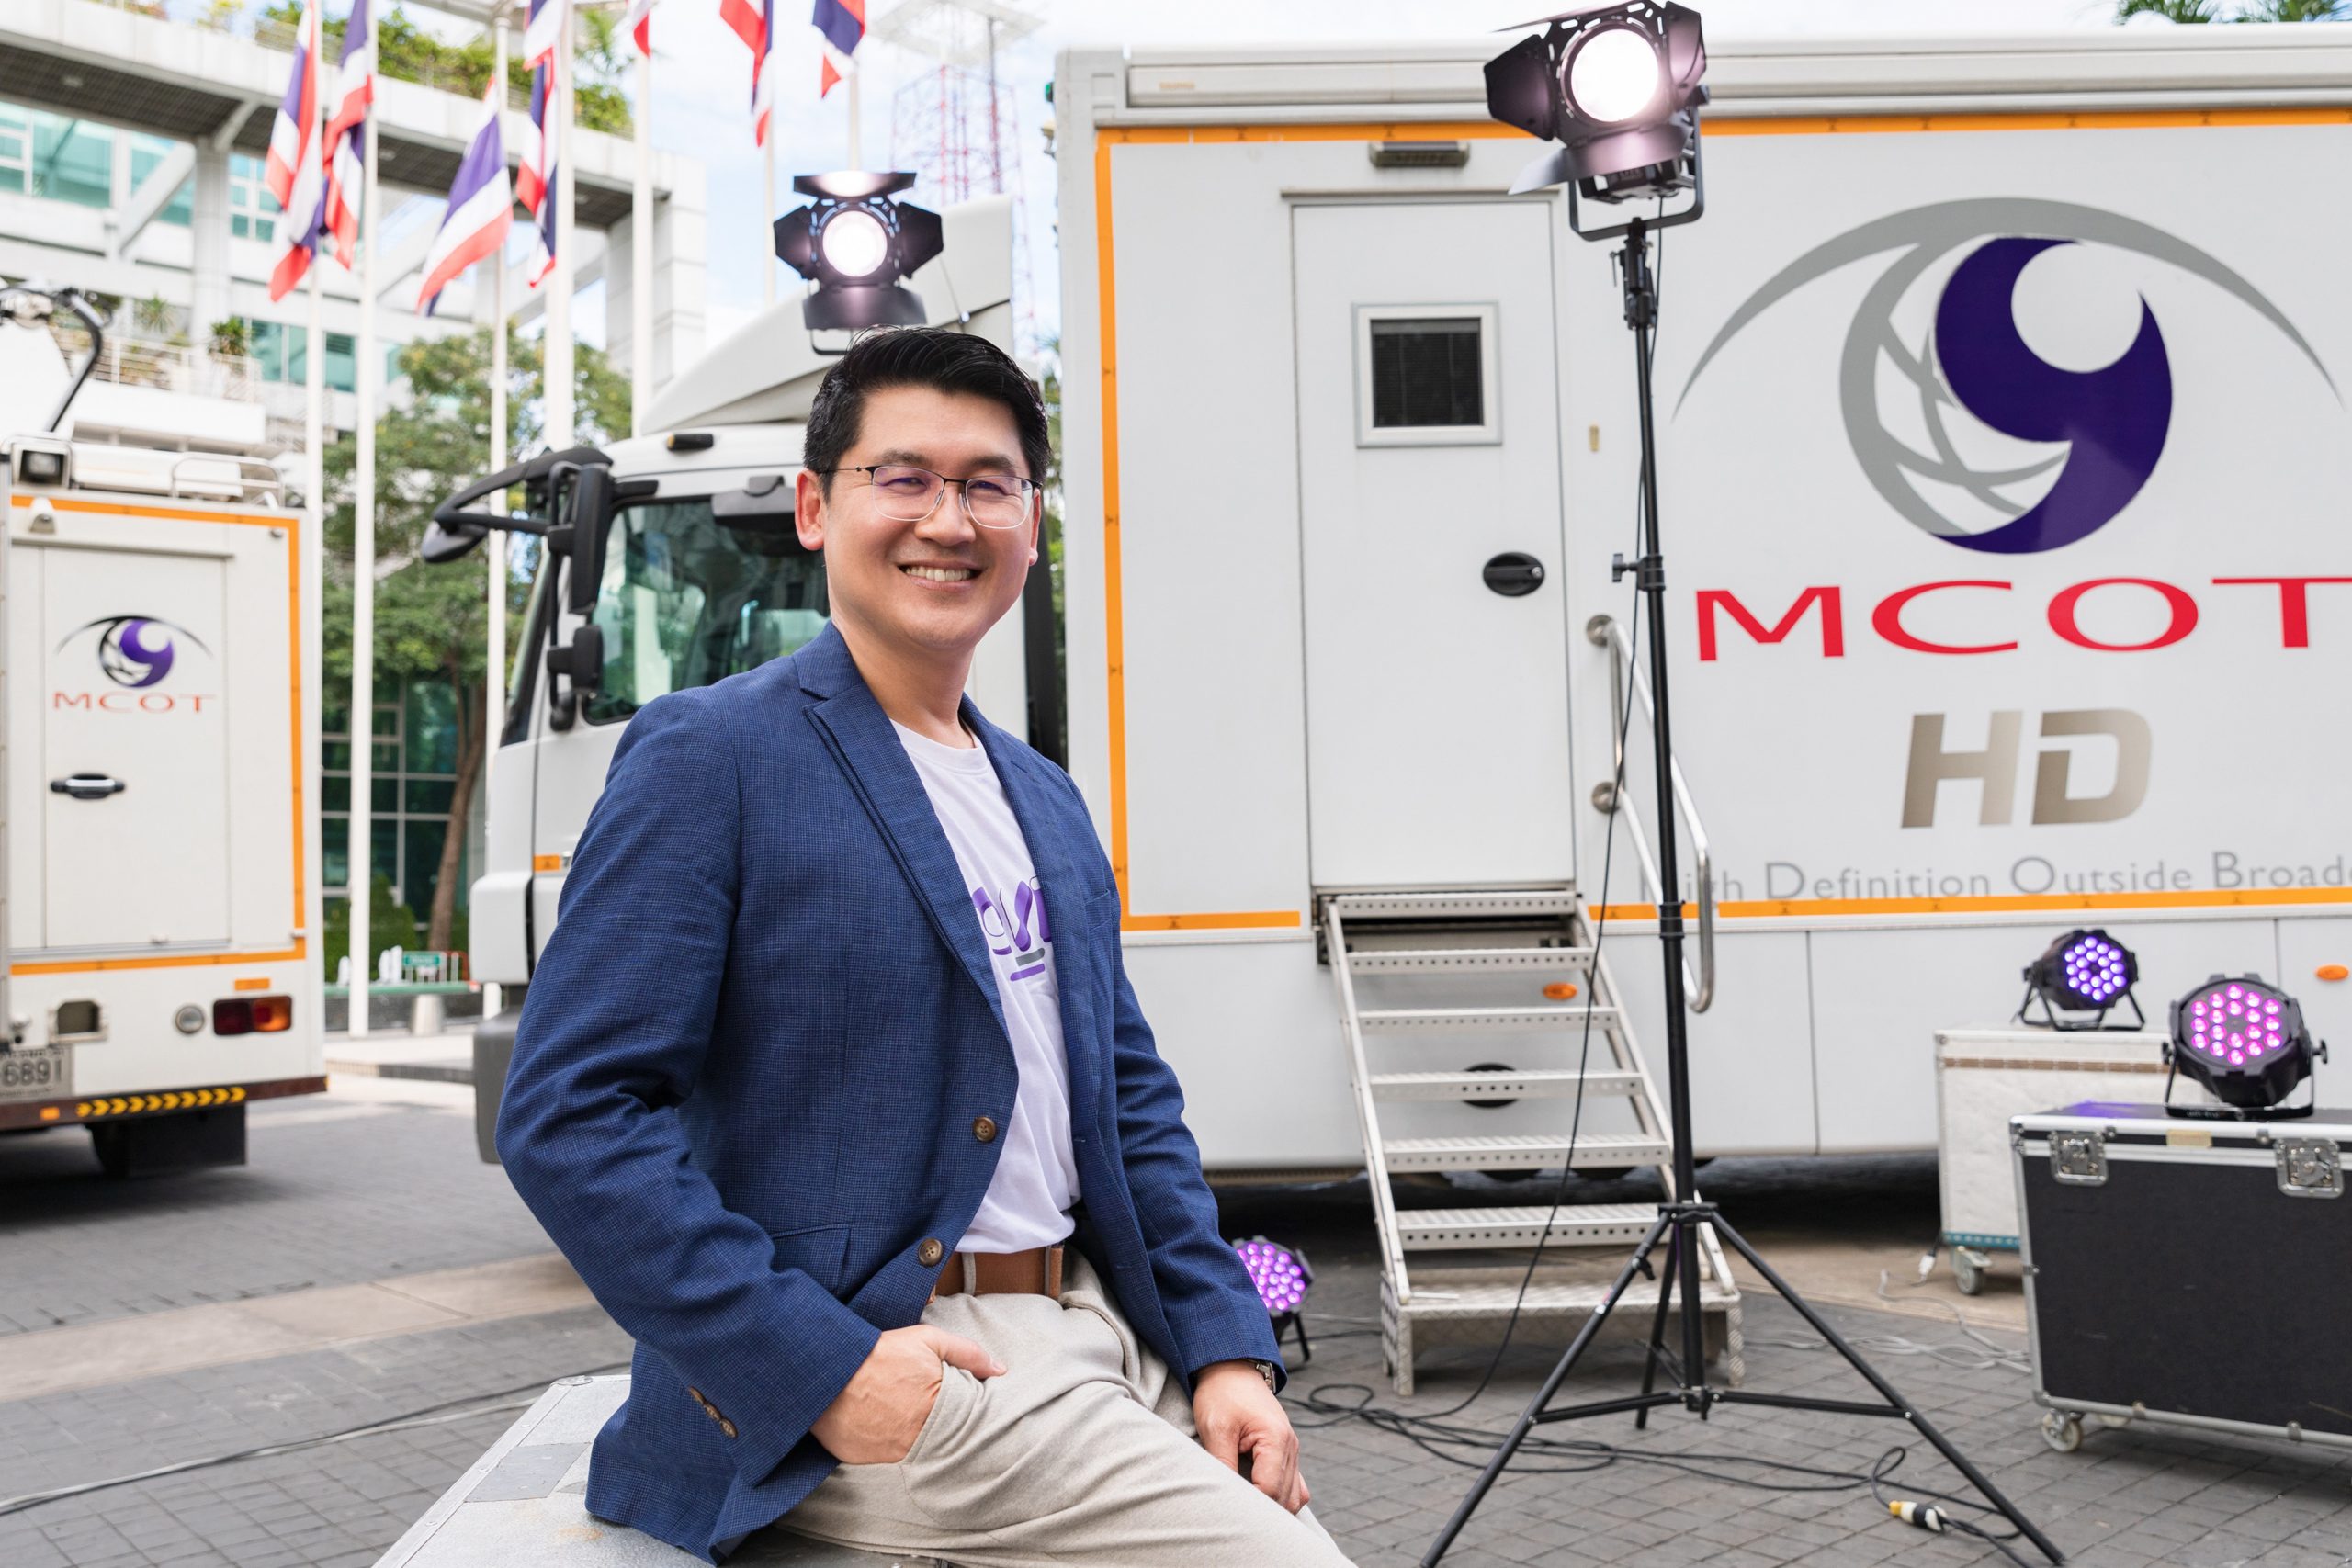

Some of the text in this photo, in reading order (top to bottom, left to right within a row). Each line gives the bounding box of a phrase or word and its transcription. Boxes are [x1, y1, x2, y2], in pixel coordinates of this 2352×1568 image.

[1696, 577, 2352, 661] MCOT
[53, 692, 216, 714] MCOT
[1901, 708, 2152, 829] HD
[1765, 861, 1991, 900] Definition
[2010, 855, 2192, 895] Outside
[2212, 851, 2352, 889] Broad
